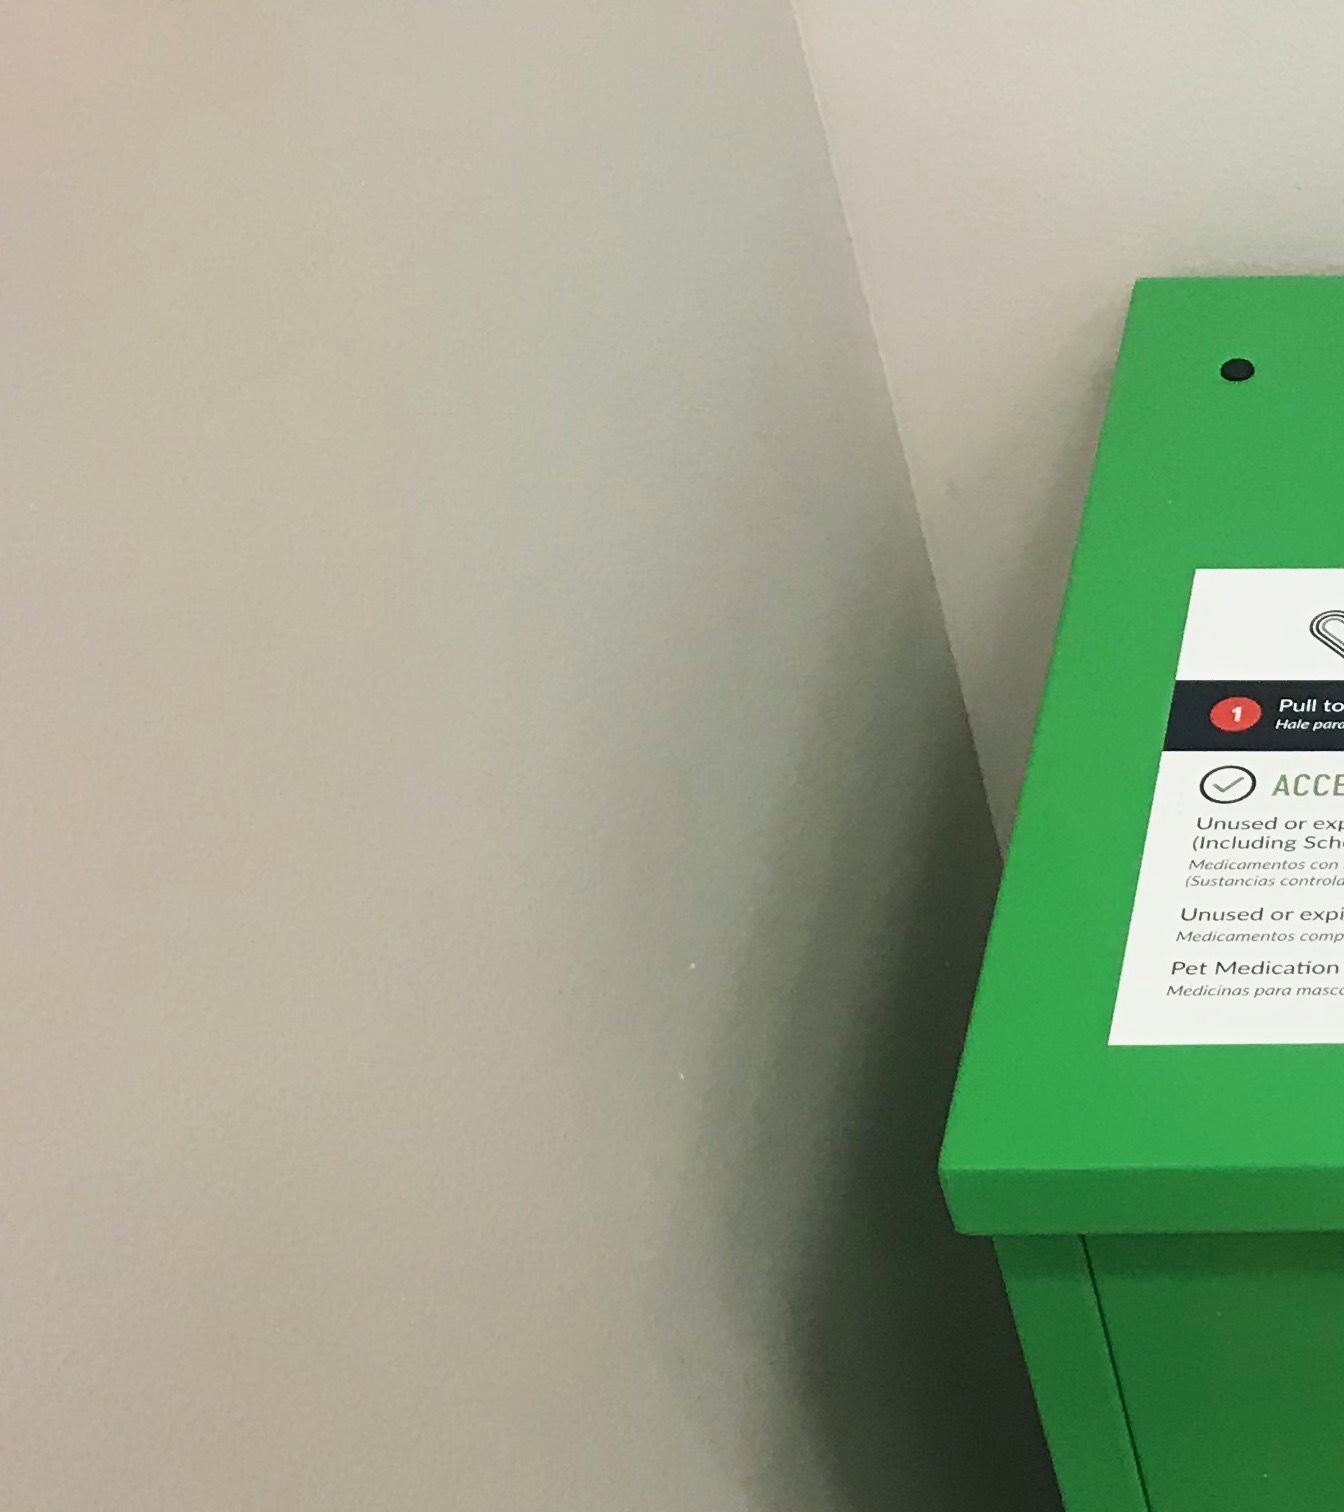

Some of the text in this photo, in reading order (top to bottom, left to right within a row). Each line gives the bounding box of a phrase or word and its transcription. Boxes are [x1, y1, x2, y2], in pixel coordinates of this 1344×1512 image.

[1278, 698, 1317, 713] Pull
[1323, 699, 1344, 713] to
[1231, 706, 1243, 723] 1
[1196, 816, 1278, 831] Unused
[1284, 819, 1308, 831] or
[1170, 960, 1340, 976] Pet Medication
